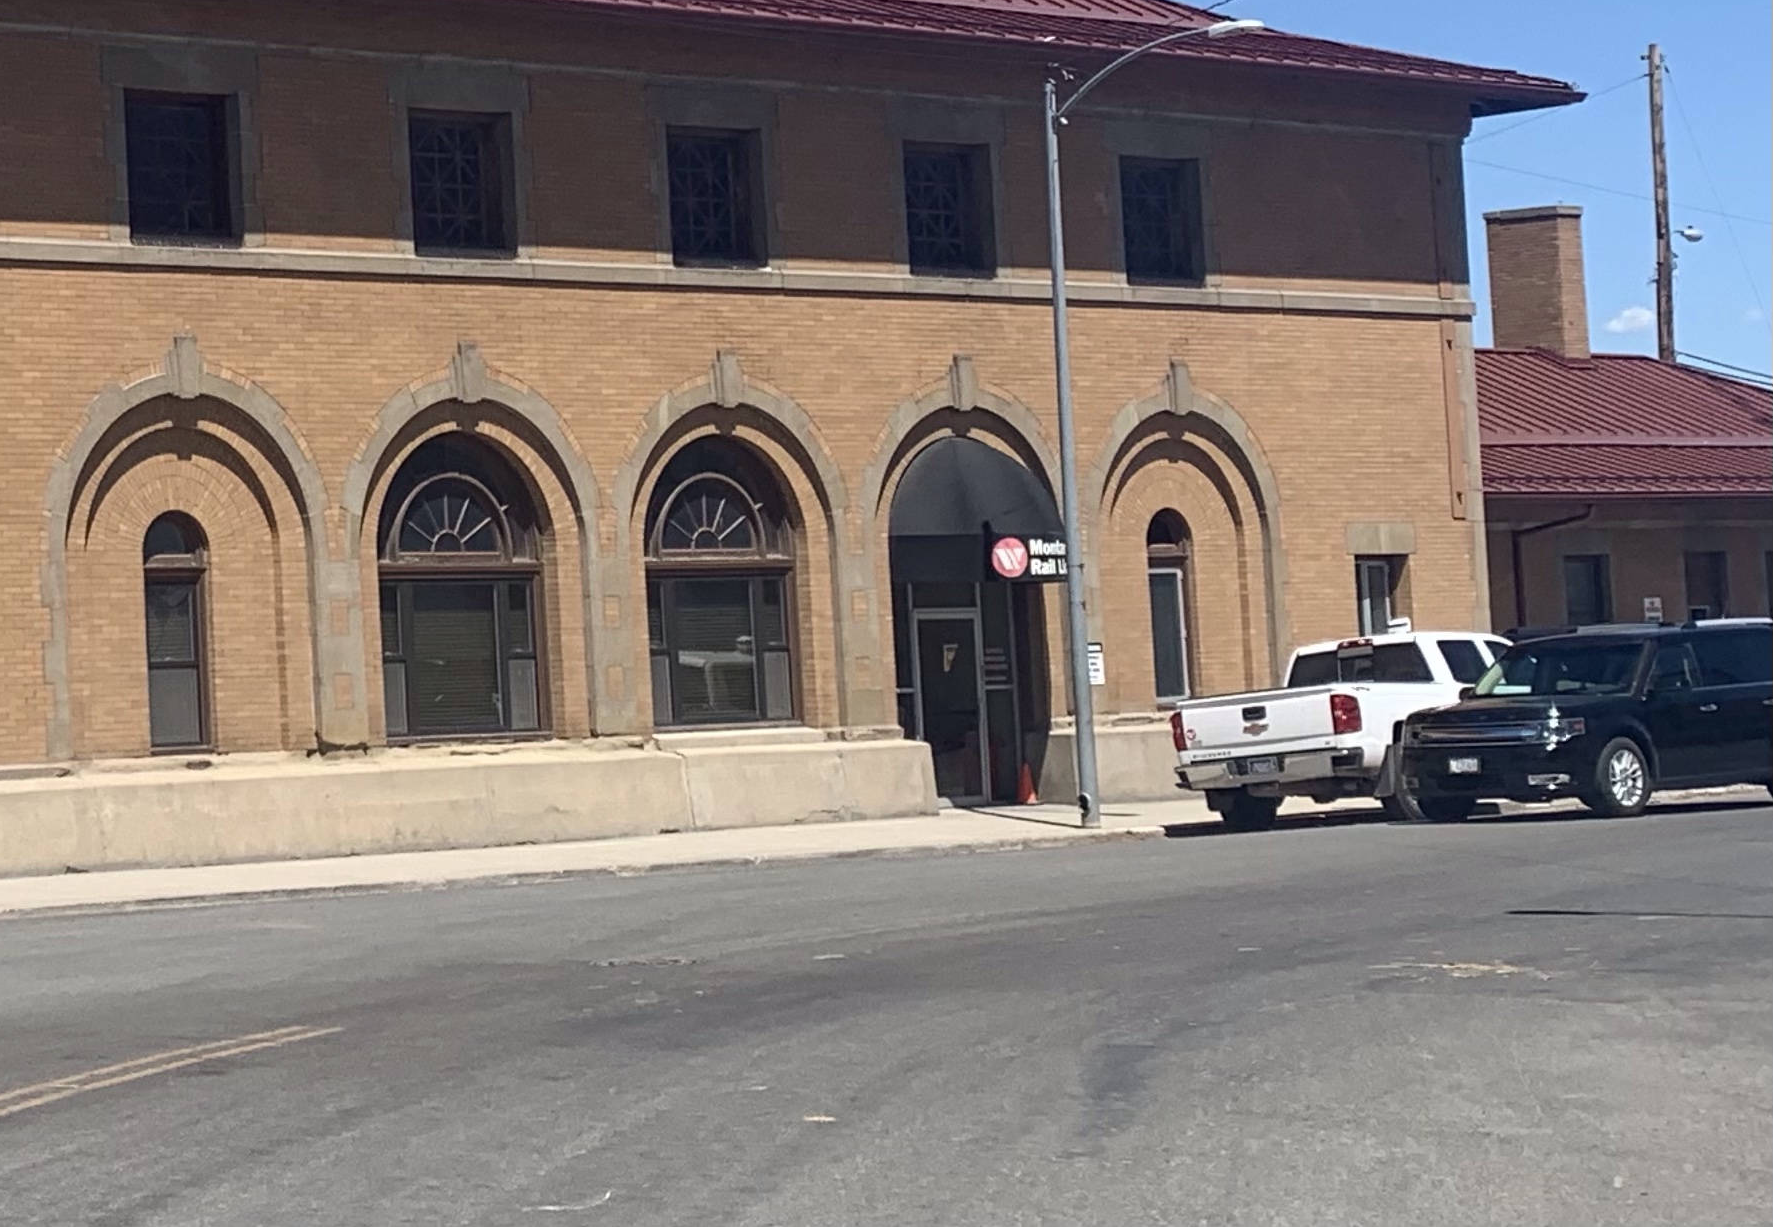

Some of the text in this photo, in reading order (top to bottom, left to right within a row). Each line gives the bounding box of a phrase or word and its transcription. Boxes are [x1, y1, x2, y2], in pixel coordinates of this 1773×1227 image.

[1029, 539, 1067, 556] Monta
[1030, 558, 1068, 575] Rail Li
